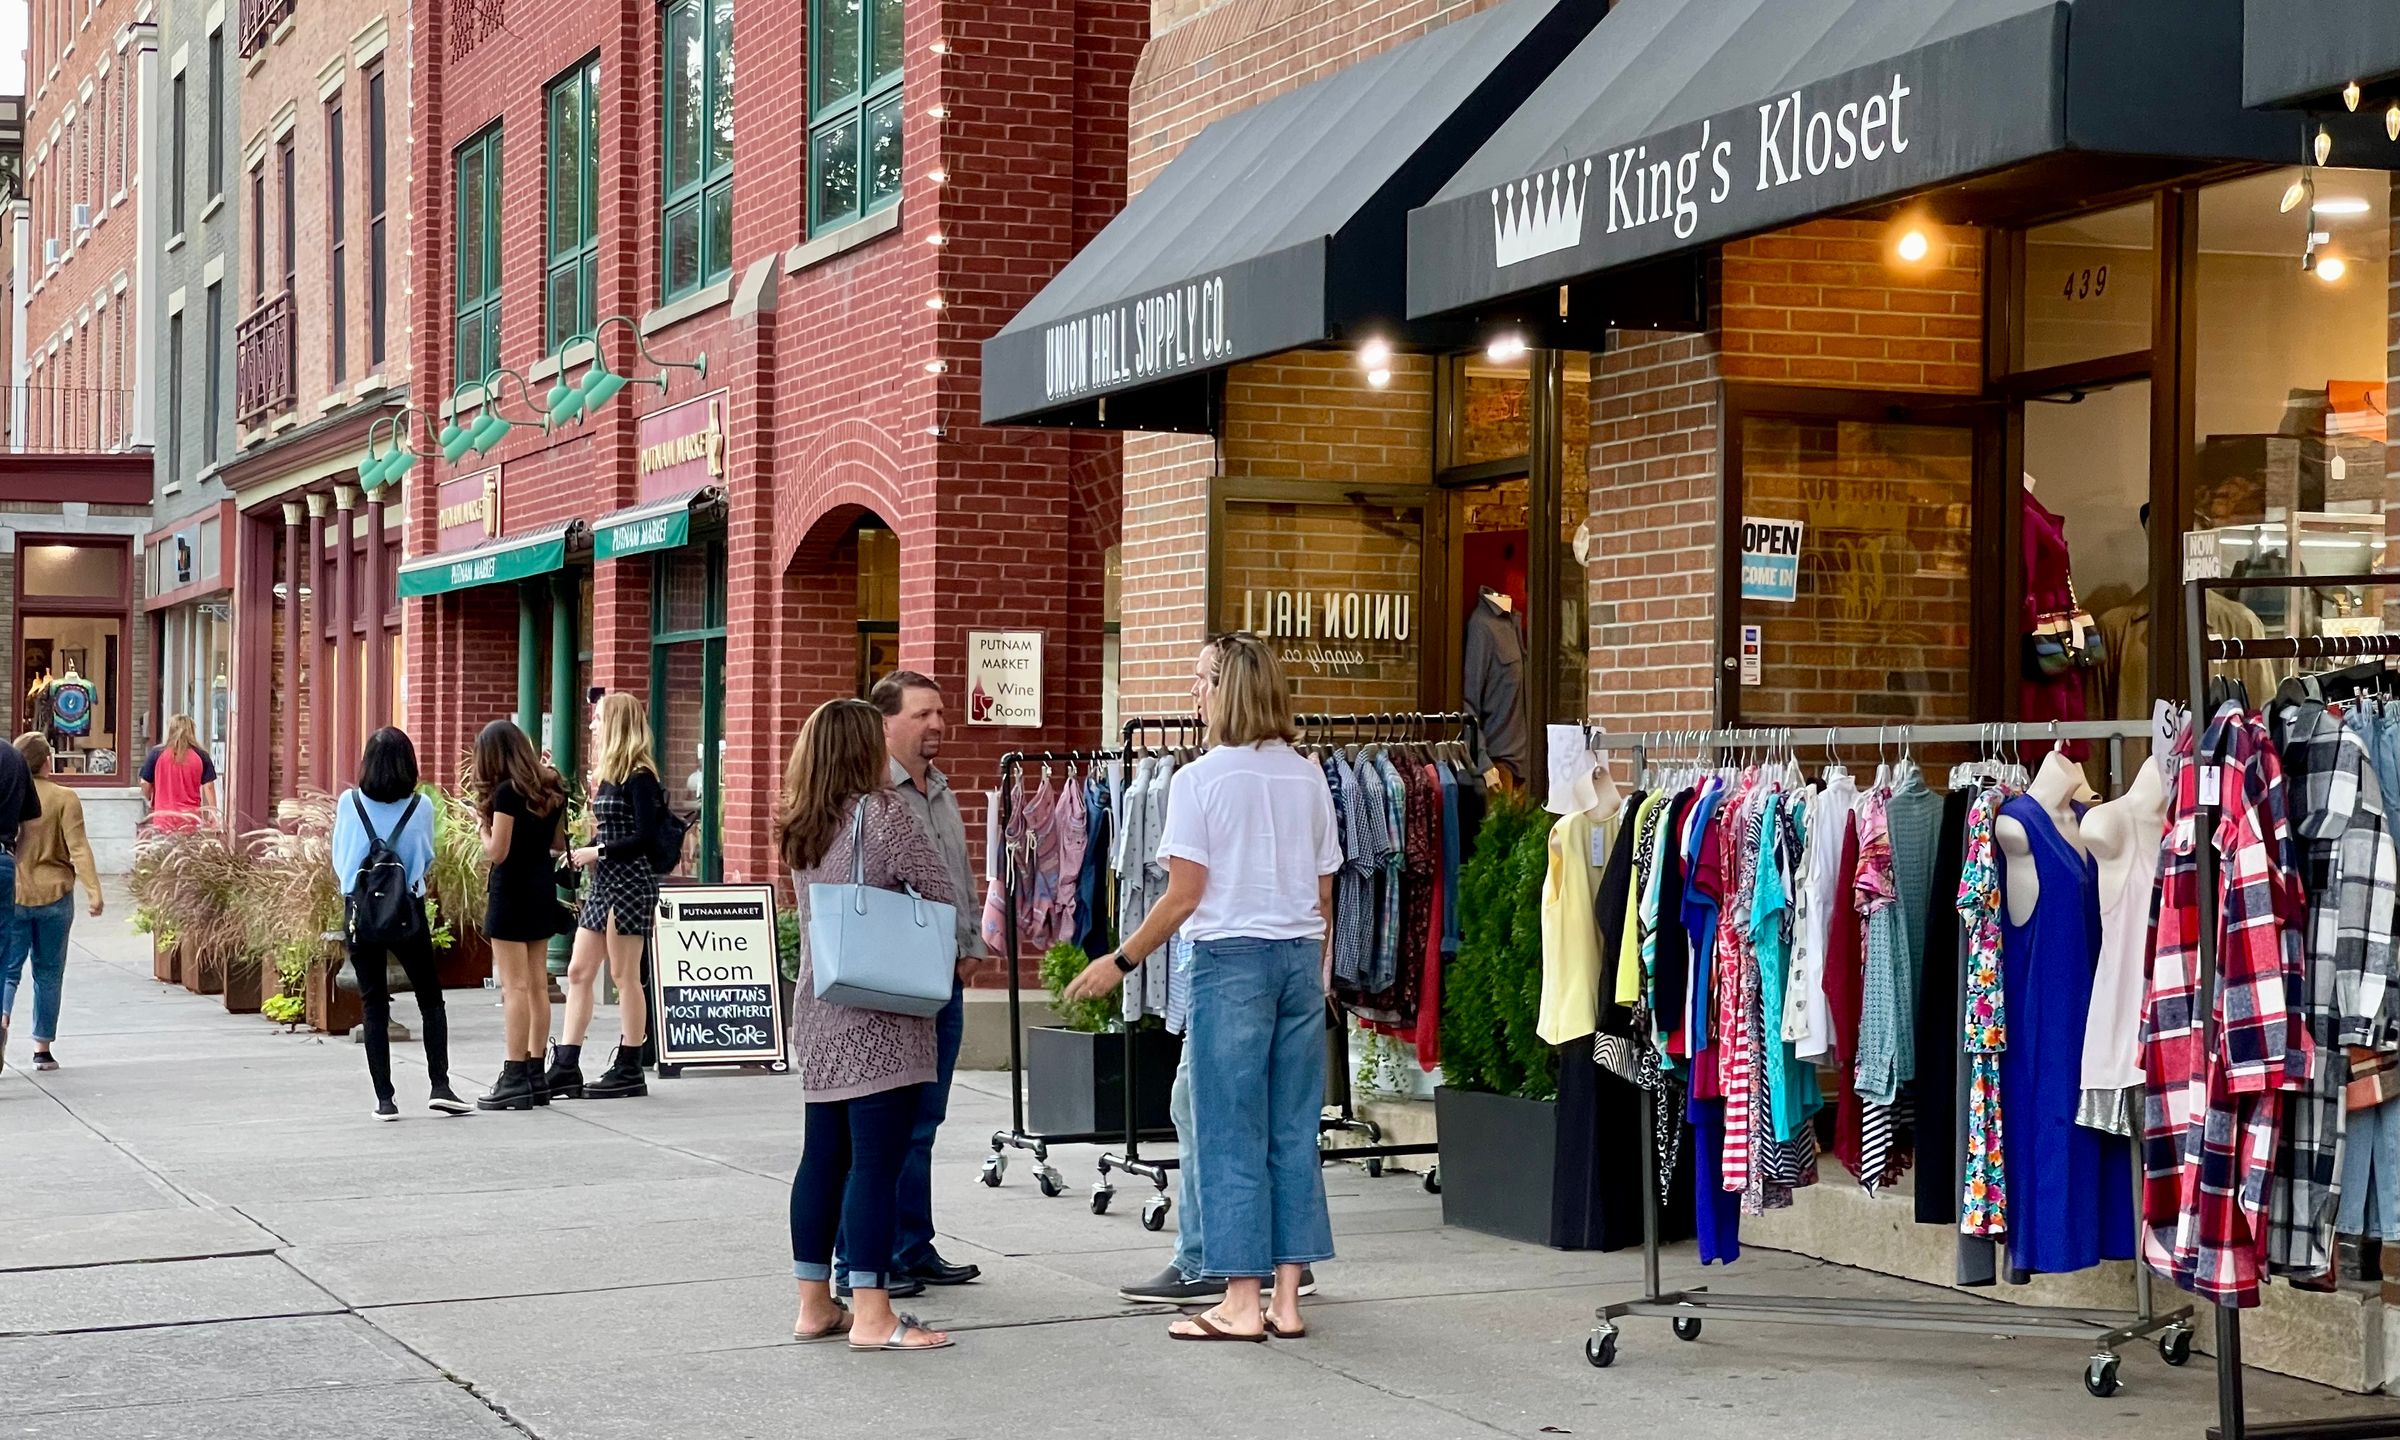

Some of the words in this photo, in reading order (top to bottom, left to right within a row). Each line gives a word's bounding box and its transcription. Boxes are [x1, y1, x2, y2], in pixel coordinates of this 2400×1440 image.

[1606, 119, 1732, 240] King's
[1755, 73, 1911, 192] Kloset
[2063, 265, 2107, 301] 439
[1046, 317, 1088, 401] UNION
[1092, 307, 1131, 389] HALL
[1135, 284, 1198, 378] SUPPLY
[1201, 276, 1232, 361] CO.
[641, 439, 676, 477] PUTNAM
[463, 498, 484, 523] MARKE
[612, 524, 640, 552] PUTNAM
[640, 517, 668, 546] MARKET
[1742, 523, 1800, 556] OPEN
[2190, 534, 2215, 556] NOW
[451, 561, 473, 585] PUTNAM
[473, 556, 496, 580] MARKET
[1742, 566, 1778, 586] COME
[1778, 568, 1794, 587] IN
[2185, 556, 2220, 579] HIRING
[980, 639, 1032, 651] PUTNAM
[981, 658, 1030, 670] MARKET
[997, 682, 1035, 696] Wine
[995, 703, 1036, 717] Room
[683, 907, 722, 917] PUTNAM
[723, 907, 760, 916] MARKET
[677, 930, 748, 951] Wine
[677, 960, 753, 982] Room
[679, 986, 767, 1003] MANHATTAN'S
[665, 1004, 703, 1019] MOST
[707, 1004, 773, 1019] NORTHERLY
